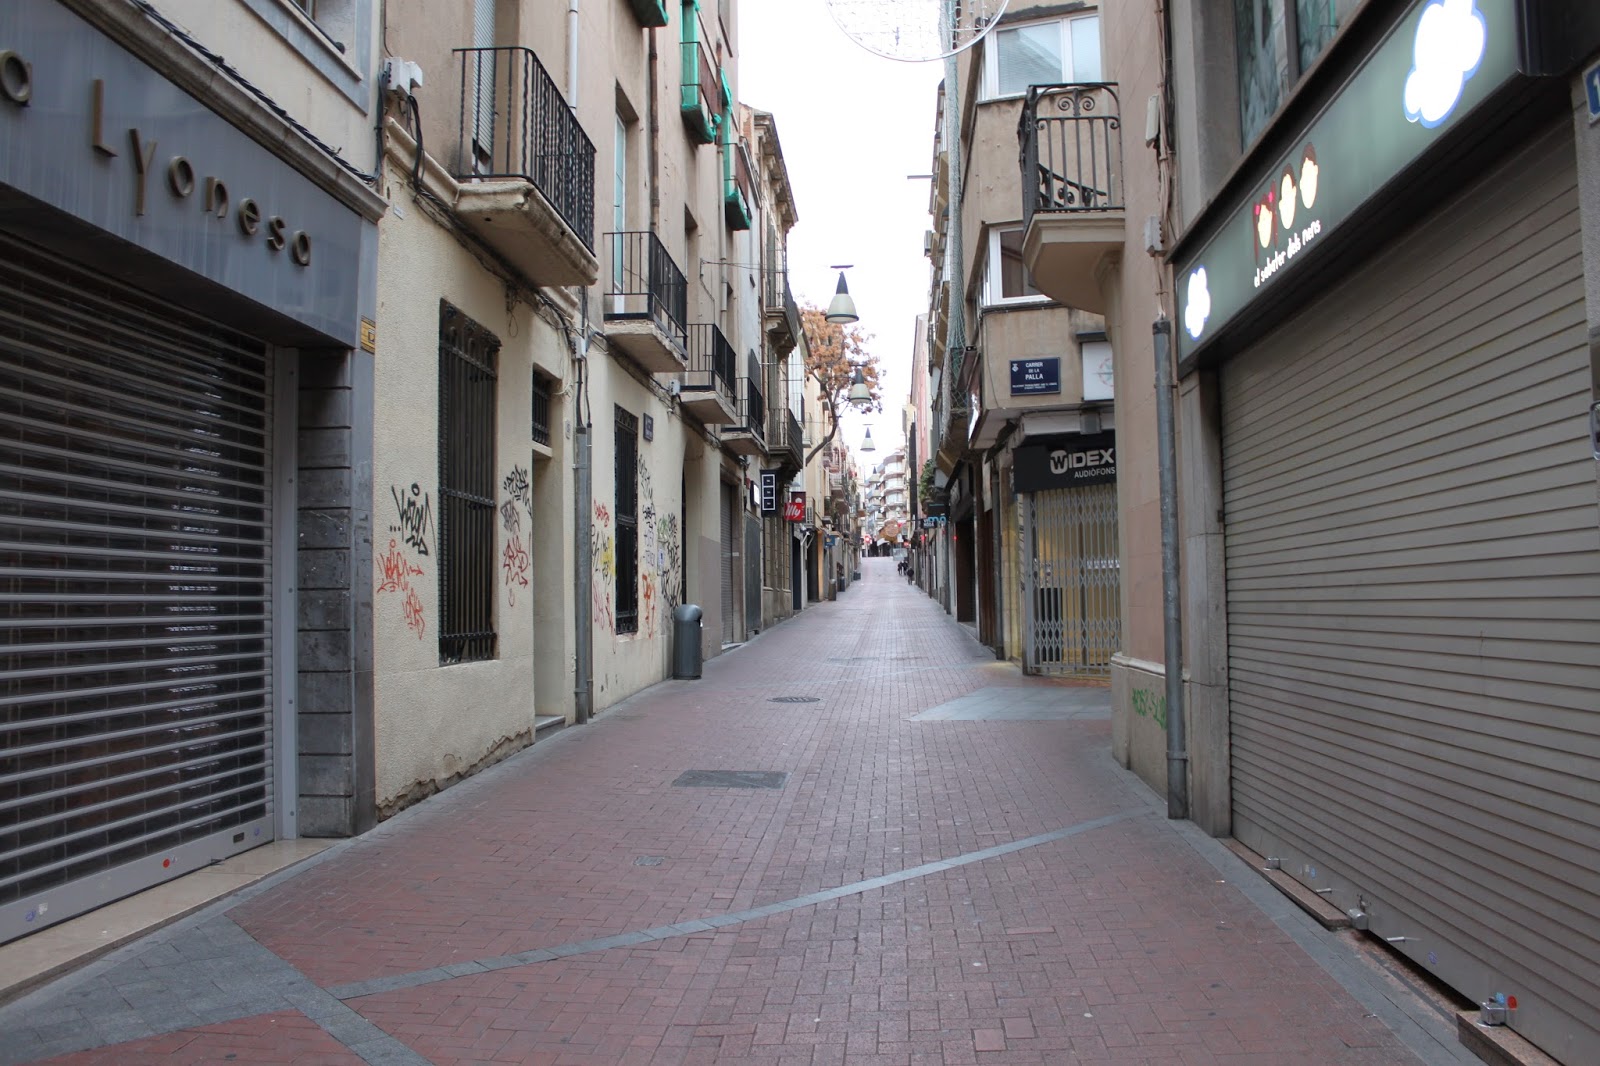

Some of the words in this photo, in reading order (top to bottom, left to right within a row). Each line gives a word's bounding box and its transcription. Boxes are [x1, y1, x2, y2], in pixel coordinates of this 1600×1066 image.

[1254, 267, 1260, 288] el
[1261, 250, 1286, 282] sabater
[1287, 232, 1301, 259] dels
[1302, 219, 1320, 246] nens
[1050, 448, 1114, 474] WIDEX
[1074, 466, 1116, 479] AUDIÒFONS
[785, 504, 801, 518] illy
